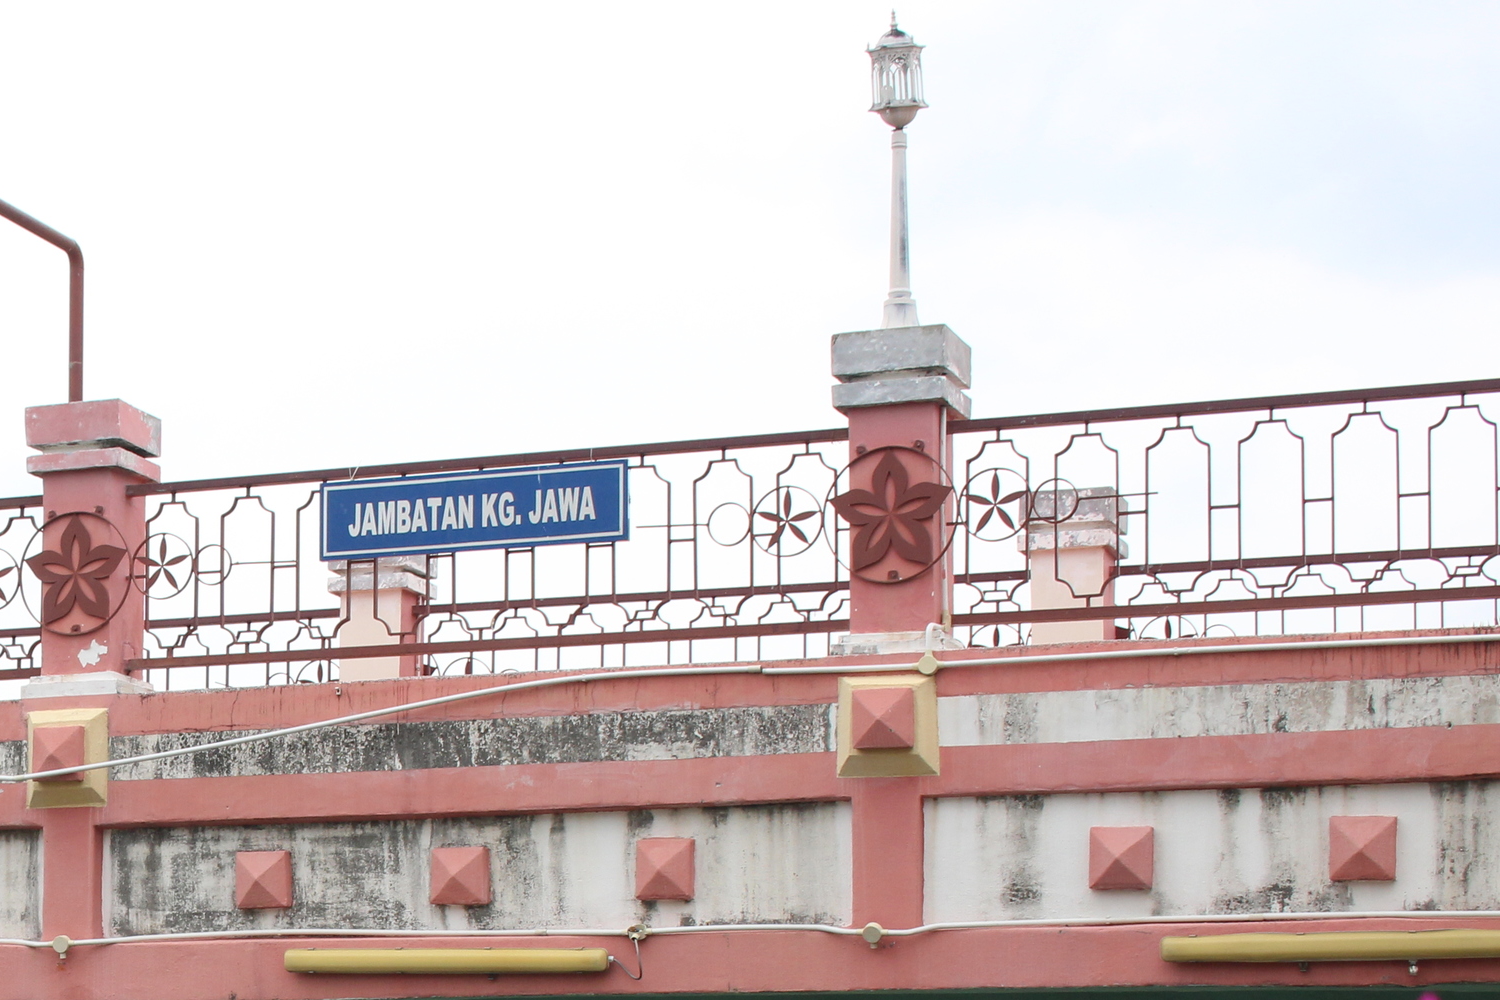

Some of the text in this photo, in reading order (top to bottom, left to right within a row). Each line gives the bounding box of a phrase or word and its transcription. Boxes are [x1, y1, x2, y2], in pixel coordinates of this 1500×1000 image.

[348, 486, 597, 537] JAMBATAN KG. JAWA
